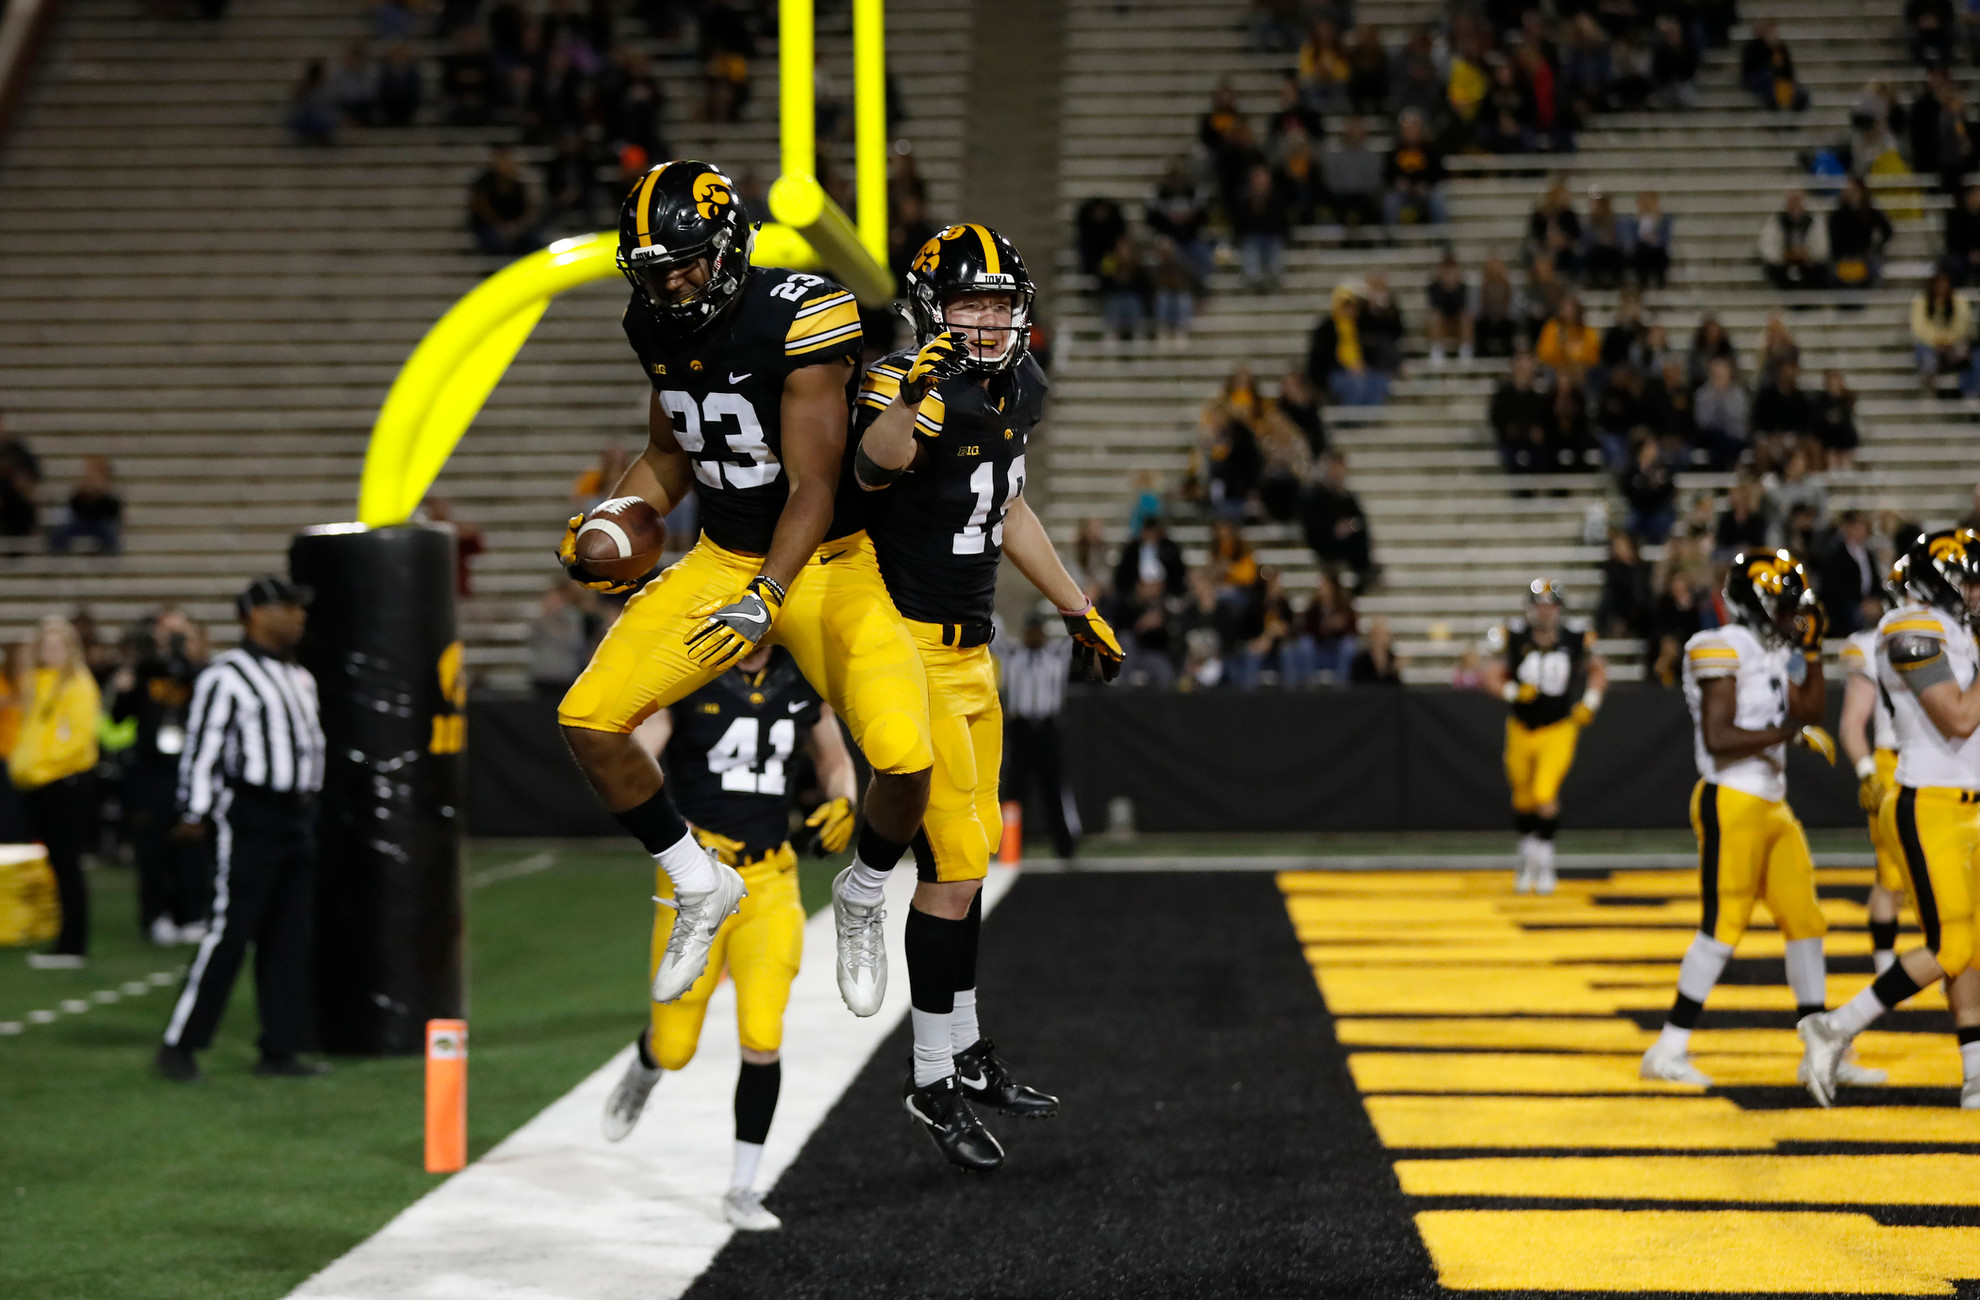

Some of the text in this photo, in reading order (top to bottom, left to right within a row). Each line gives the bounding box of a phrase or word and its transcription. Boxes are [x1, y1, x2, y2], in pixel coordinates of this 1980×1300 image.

[769, 273, 825, 302] 23
[984, 275, 1008, 284] IOWA
[659, 389, 782, 490] 23
[706, 716, 795, 796] 41
